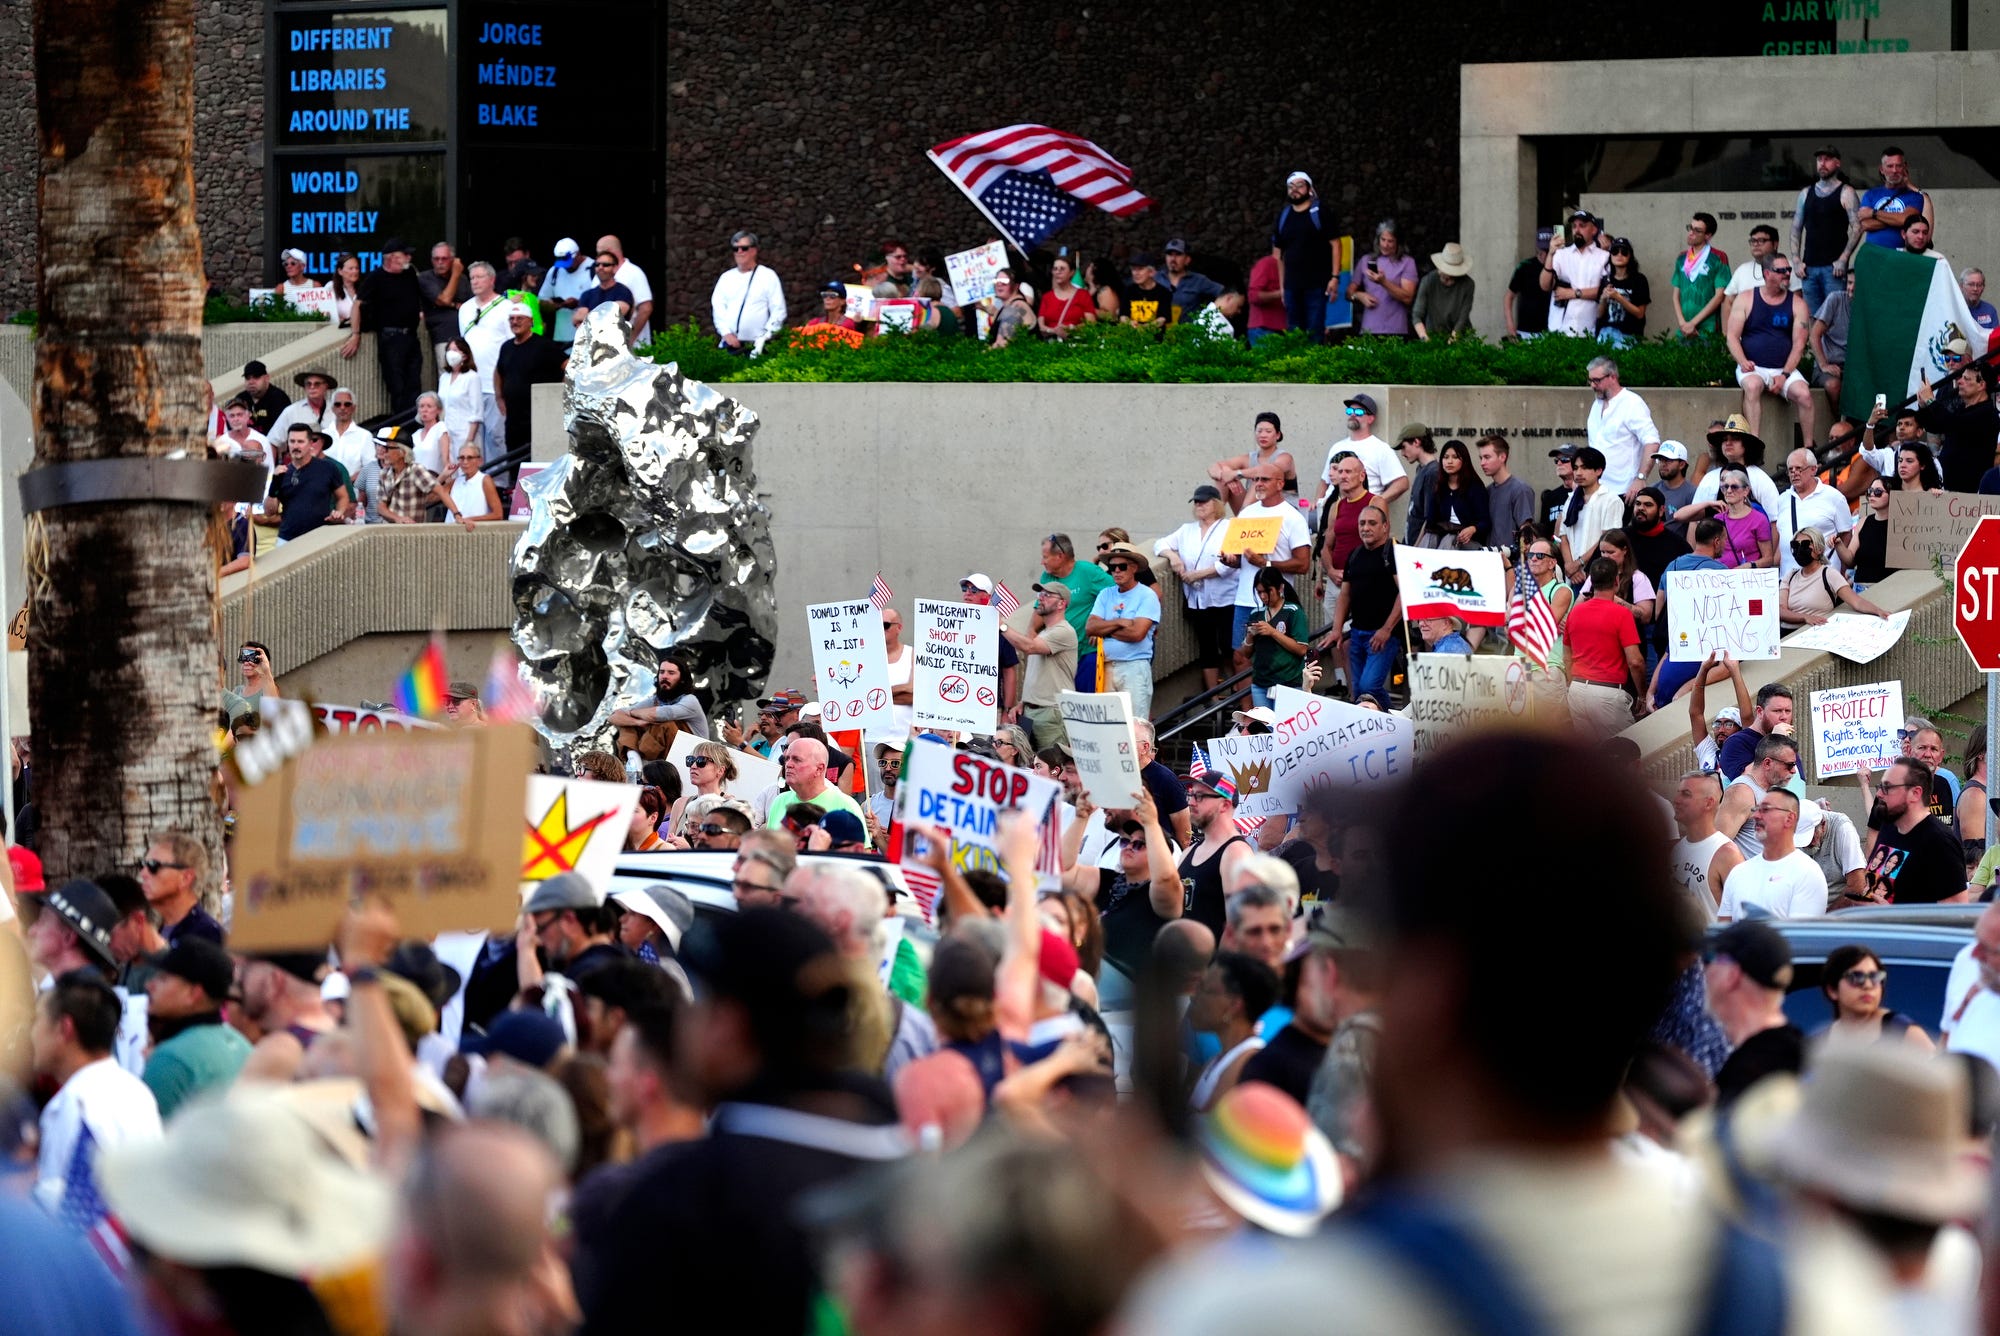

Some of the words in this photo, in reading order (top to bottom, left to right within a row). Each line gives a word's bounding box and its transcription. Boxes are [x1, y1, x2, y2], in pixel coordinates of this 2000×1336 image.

[1762, 1, 1776, 22] A
[1781, 0, 1820, 22] JAR
[1825, 0, 1880, 21] WITH
[290, 26, 393, 51] DIFFERENT
[478, 22, 542, 45] JORGE
[290, 67, 387, 92] LIBRARIES
[478, 57, 557, 87] MÉNDEZ
[289, 109, 369, 132] AROUND
[372, 108, 410, 130] THE
[478, 103, 538, 126] BLAKE
[291, 170, 359, 194] WORLD
[291, 211, 379, 234] ENTIRELY
[357, 252, 383, 274] TH
[297, 290, 333, 302] IMPEACH
[1457, 428, 1477, 438] AND
[1556, 428, 1588, 438] STAIRC
[1240, 529, 1265, 539] DICK
[1674, 573, 1693, 590] NO
[1695, 573, 1737, 590] MORE
[1741, 570, 1776, 590] HATE
[1961, 566, 1999, 621] ST
[811, 606, 840, 620] DONALD
[843, 603, 870, 616] TRUMP
[919, 602, 982, 621] IMMIGRANTS
[1693, 594, 1726, 625] NOT
[1728, 594, 1743, 619] A
[831, 621, 842, 633] IS
[852, 617, 859, 629] A
[929, 628, 960, 644] SHOOT
[964, 633, 977, 645] UP
[1697, 619, 1760, 656] KING
[925, 641, 965, 660] SCHOOLS
[828, 667, 835, 678] C
[857, 663, 864, 674] P
[915, 654, 946, 669] MUSIC
[951, 660, 998, 678] FESTIVALS
[1416, 664, 1436, 691] THE
[1438, 665, 1469, 702] ONLY
[1819, 692, 1847, 703] Getting
[1411, 700, 1472, 729] NECESSARY
[1822, 695, 1890, 724] PROTECT
[1276, 700, 1322, 746] STOP
[1217, 737, 1238, 757] NO
[1274, 717, 1397, 778] DEPORTATIONS
[1823, 728, 1855, 746] Rights
[1858, 726, 1889, 743] People
[1826, 743, 1883, 761] Democracy
[1347, 745, 1399, 786] ICE
[1821, 763, 1833, 775] NO
[951, 754, 1028, 808] STOP
[919, 787, 999, 836] DETAIN
[1238, 802, 1253, 815] In
[1260, 797, 1283, 812] USA
[1684, 862, 1705, 883] DADS
